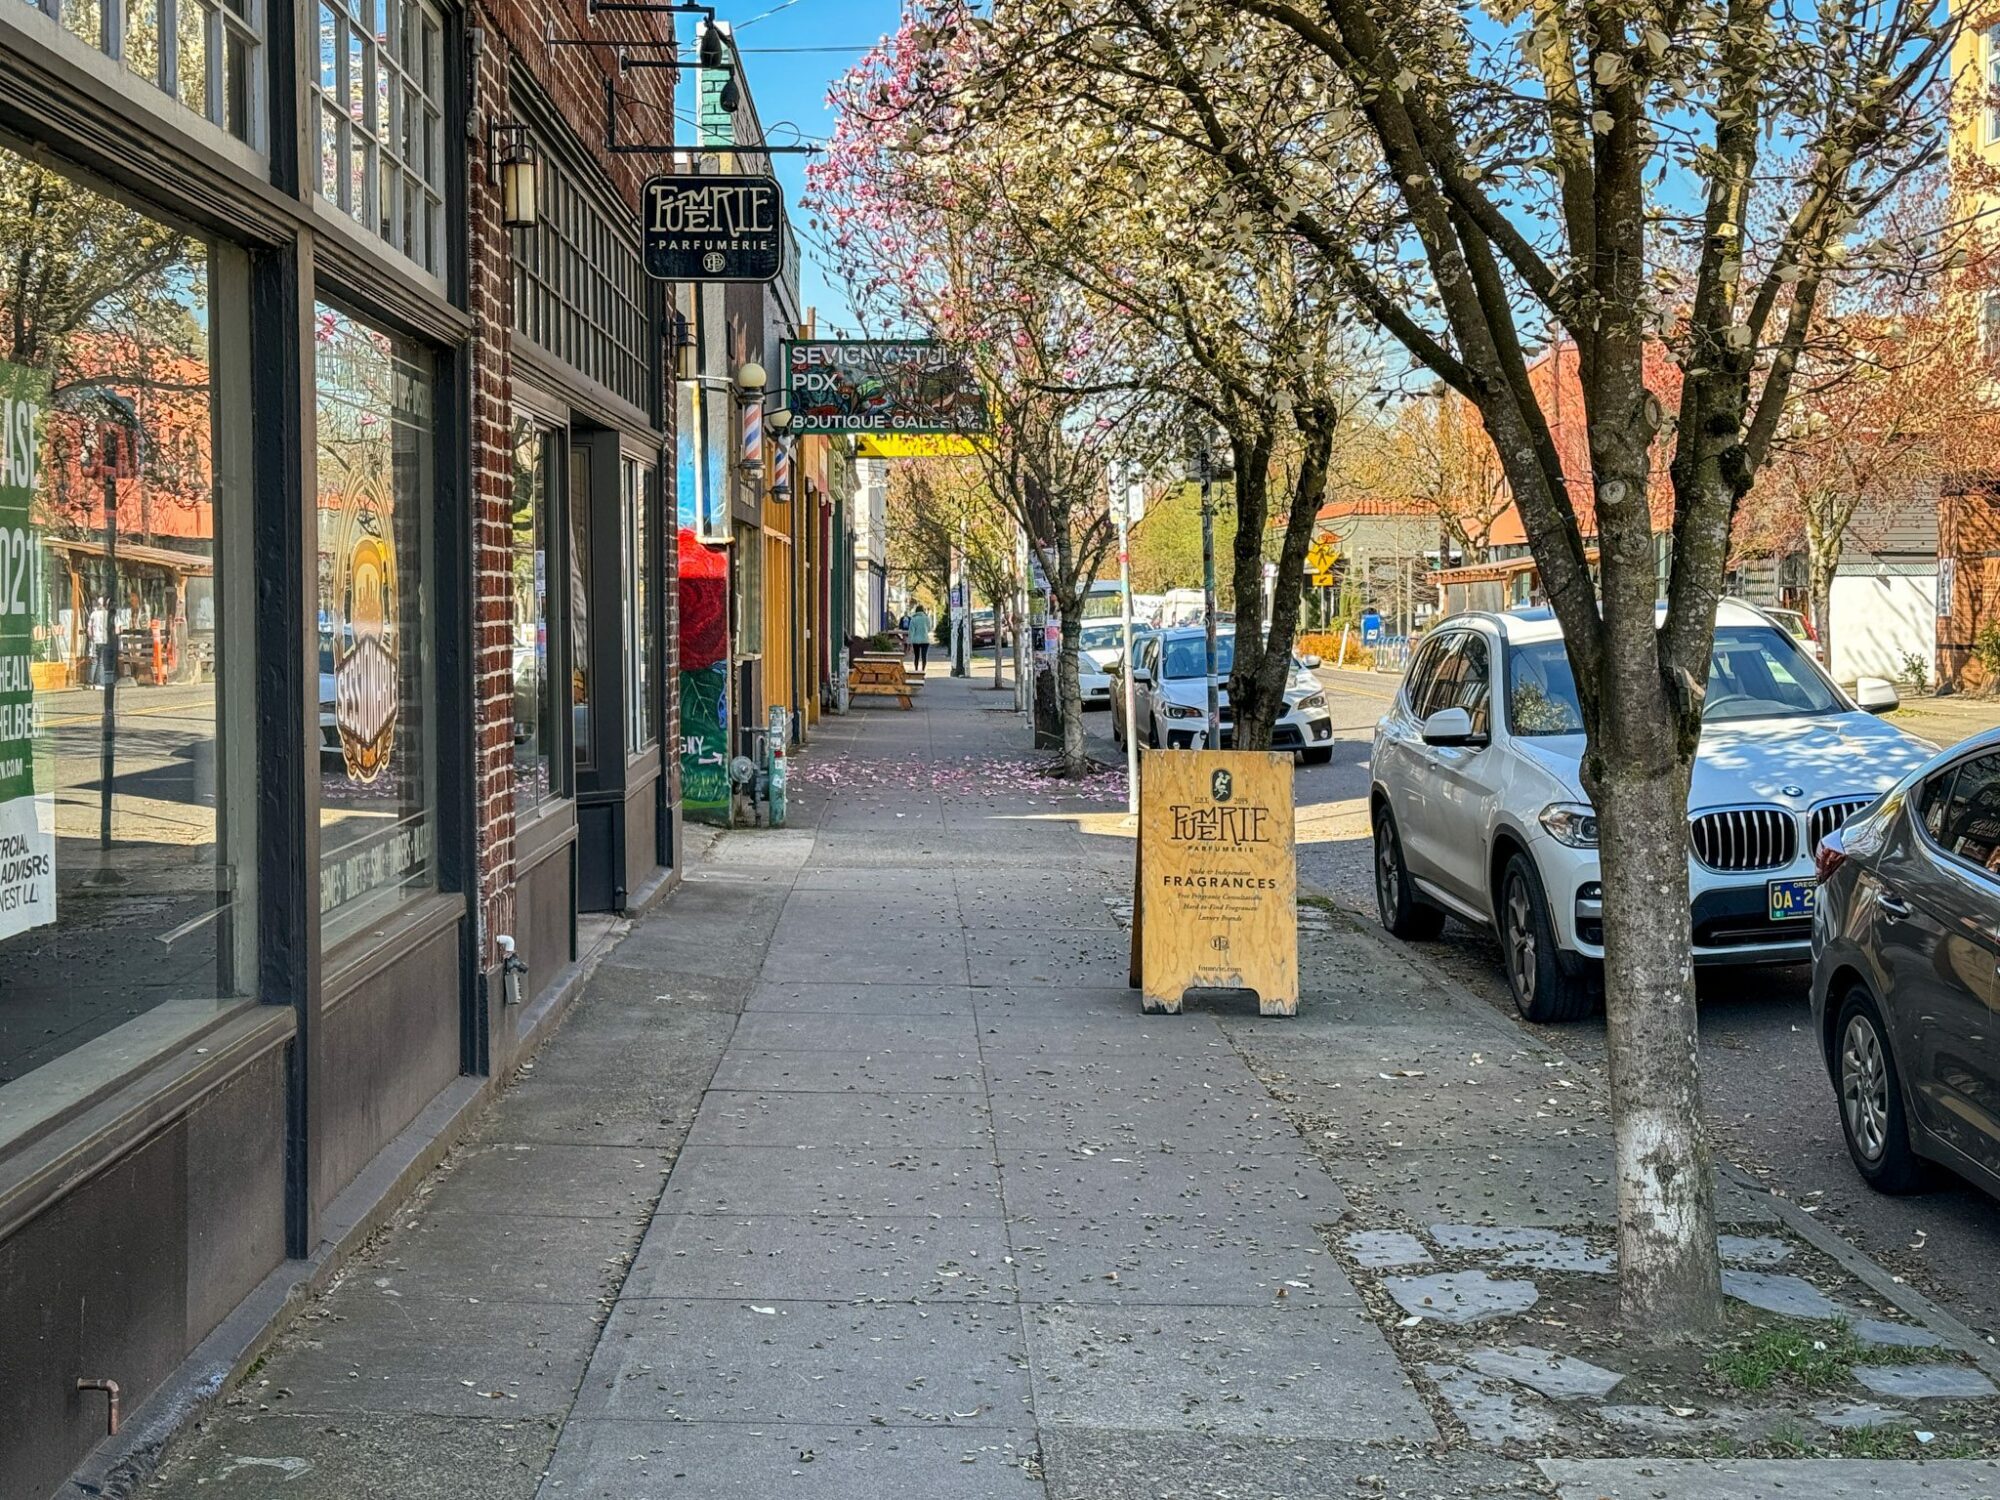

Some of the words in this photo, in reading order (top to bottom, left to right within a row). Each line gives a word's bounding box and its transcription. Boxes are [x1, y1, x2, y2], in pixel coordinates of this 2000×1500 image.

[792, 347, 887, 364] SEVIGNY
[792, 373, 838, 391] PDX
[792, 415, 885, 429] BOUTIQUE
[337, 639, 397, 744] SESSIONABLE
[1187, 845, 1254, 853] PARFUMERIE
[1163, 875, 1276, 889] FRAGRANCES
